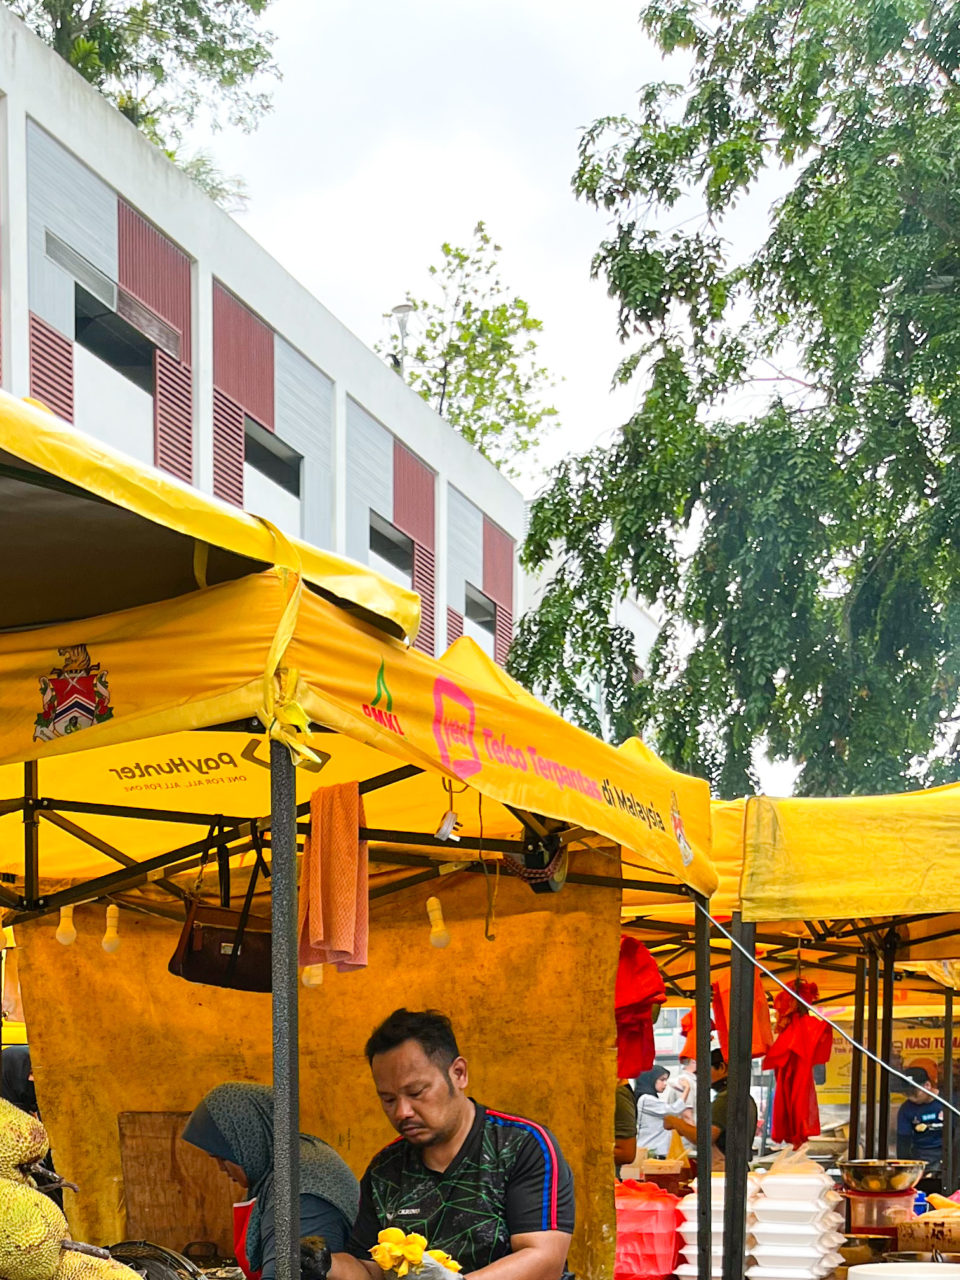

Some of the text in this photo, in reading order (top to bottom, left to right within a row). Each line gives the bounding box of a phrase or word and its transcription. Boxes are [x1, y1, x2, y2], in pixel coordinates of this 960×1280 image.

[482, 727, 666, 833] Telco Terpantas di Malaysia
[905, 1036, 931, 1049] NASI
